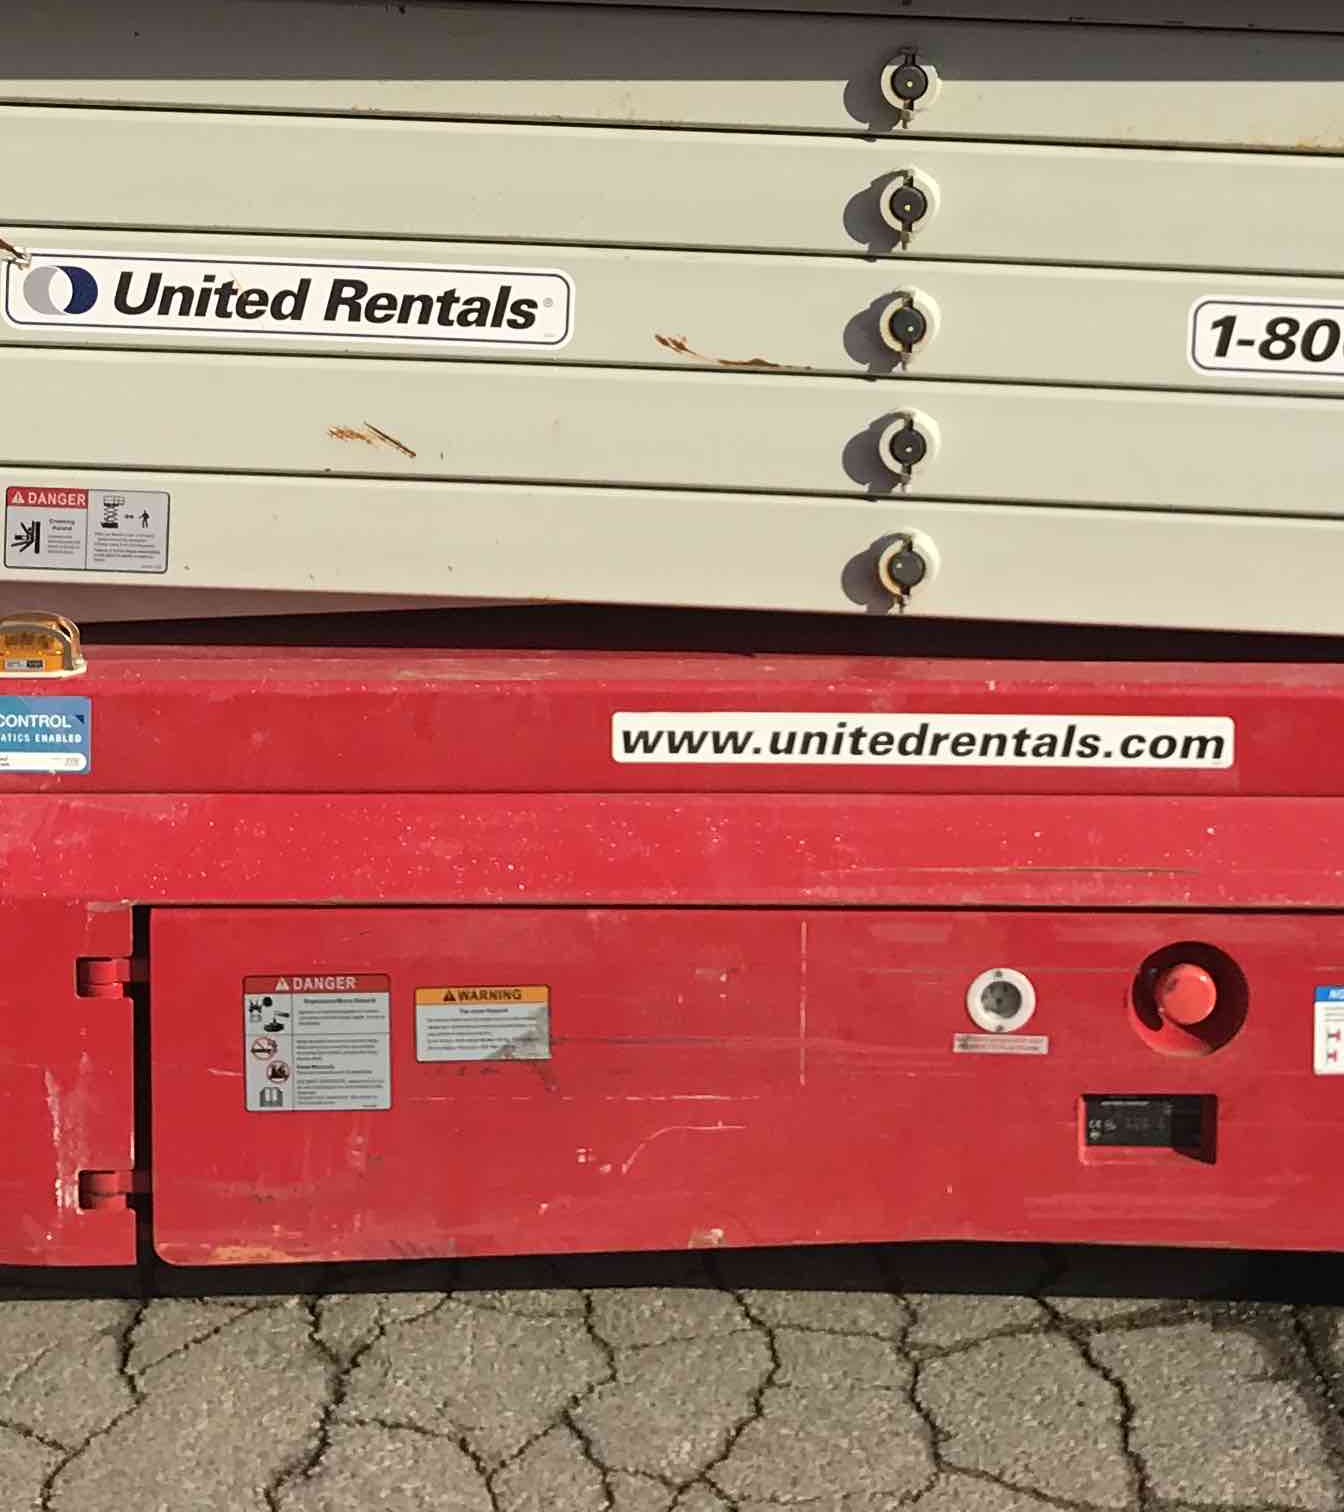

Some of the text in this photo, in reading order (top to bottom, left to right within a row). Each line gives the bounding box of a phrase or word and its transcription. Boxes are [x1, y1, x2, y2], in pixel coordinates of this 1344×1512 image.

[113, 271, 539, 330] United Rentals
[27, 491, 86, 506] DANGER
[621, 721, 1225, 760] www.unitedrentals.com
[293, 976, 357, 990] DANGER
[457, 989, 522, 1001] WARNING
